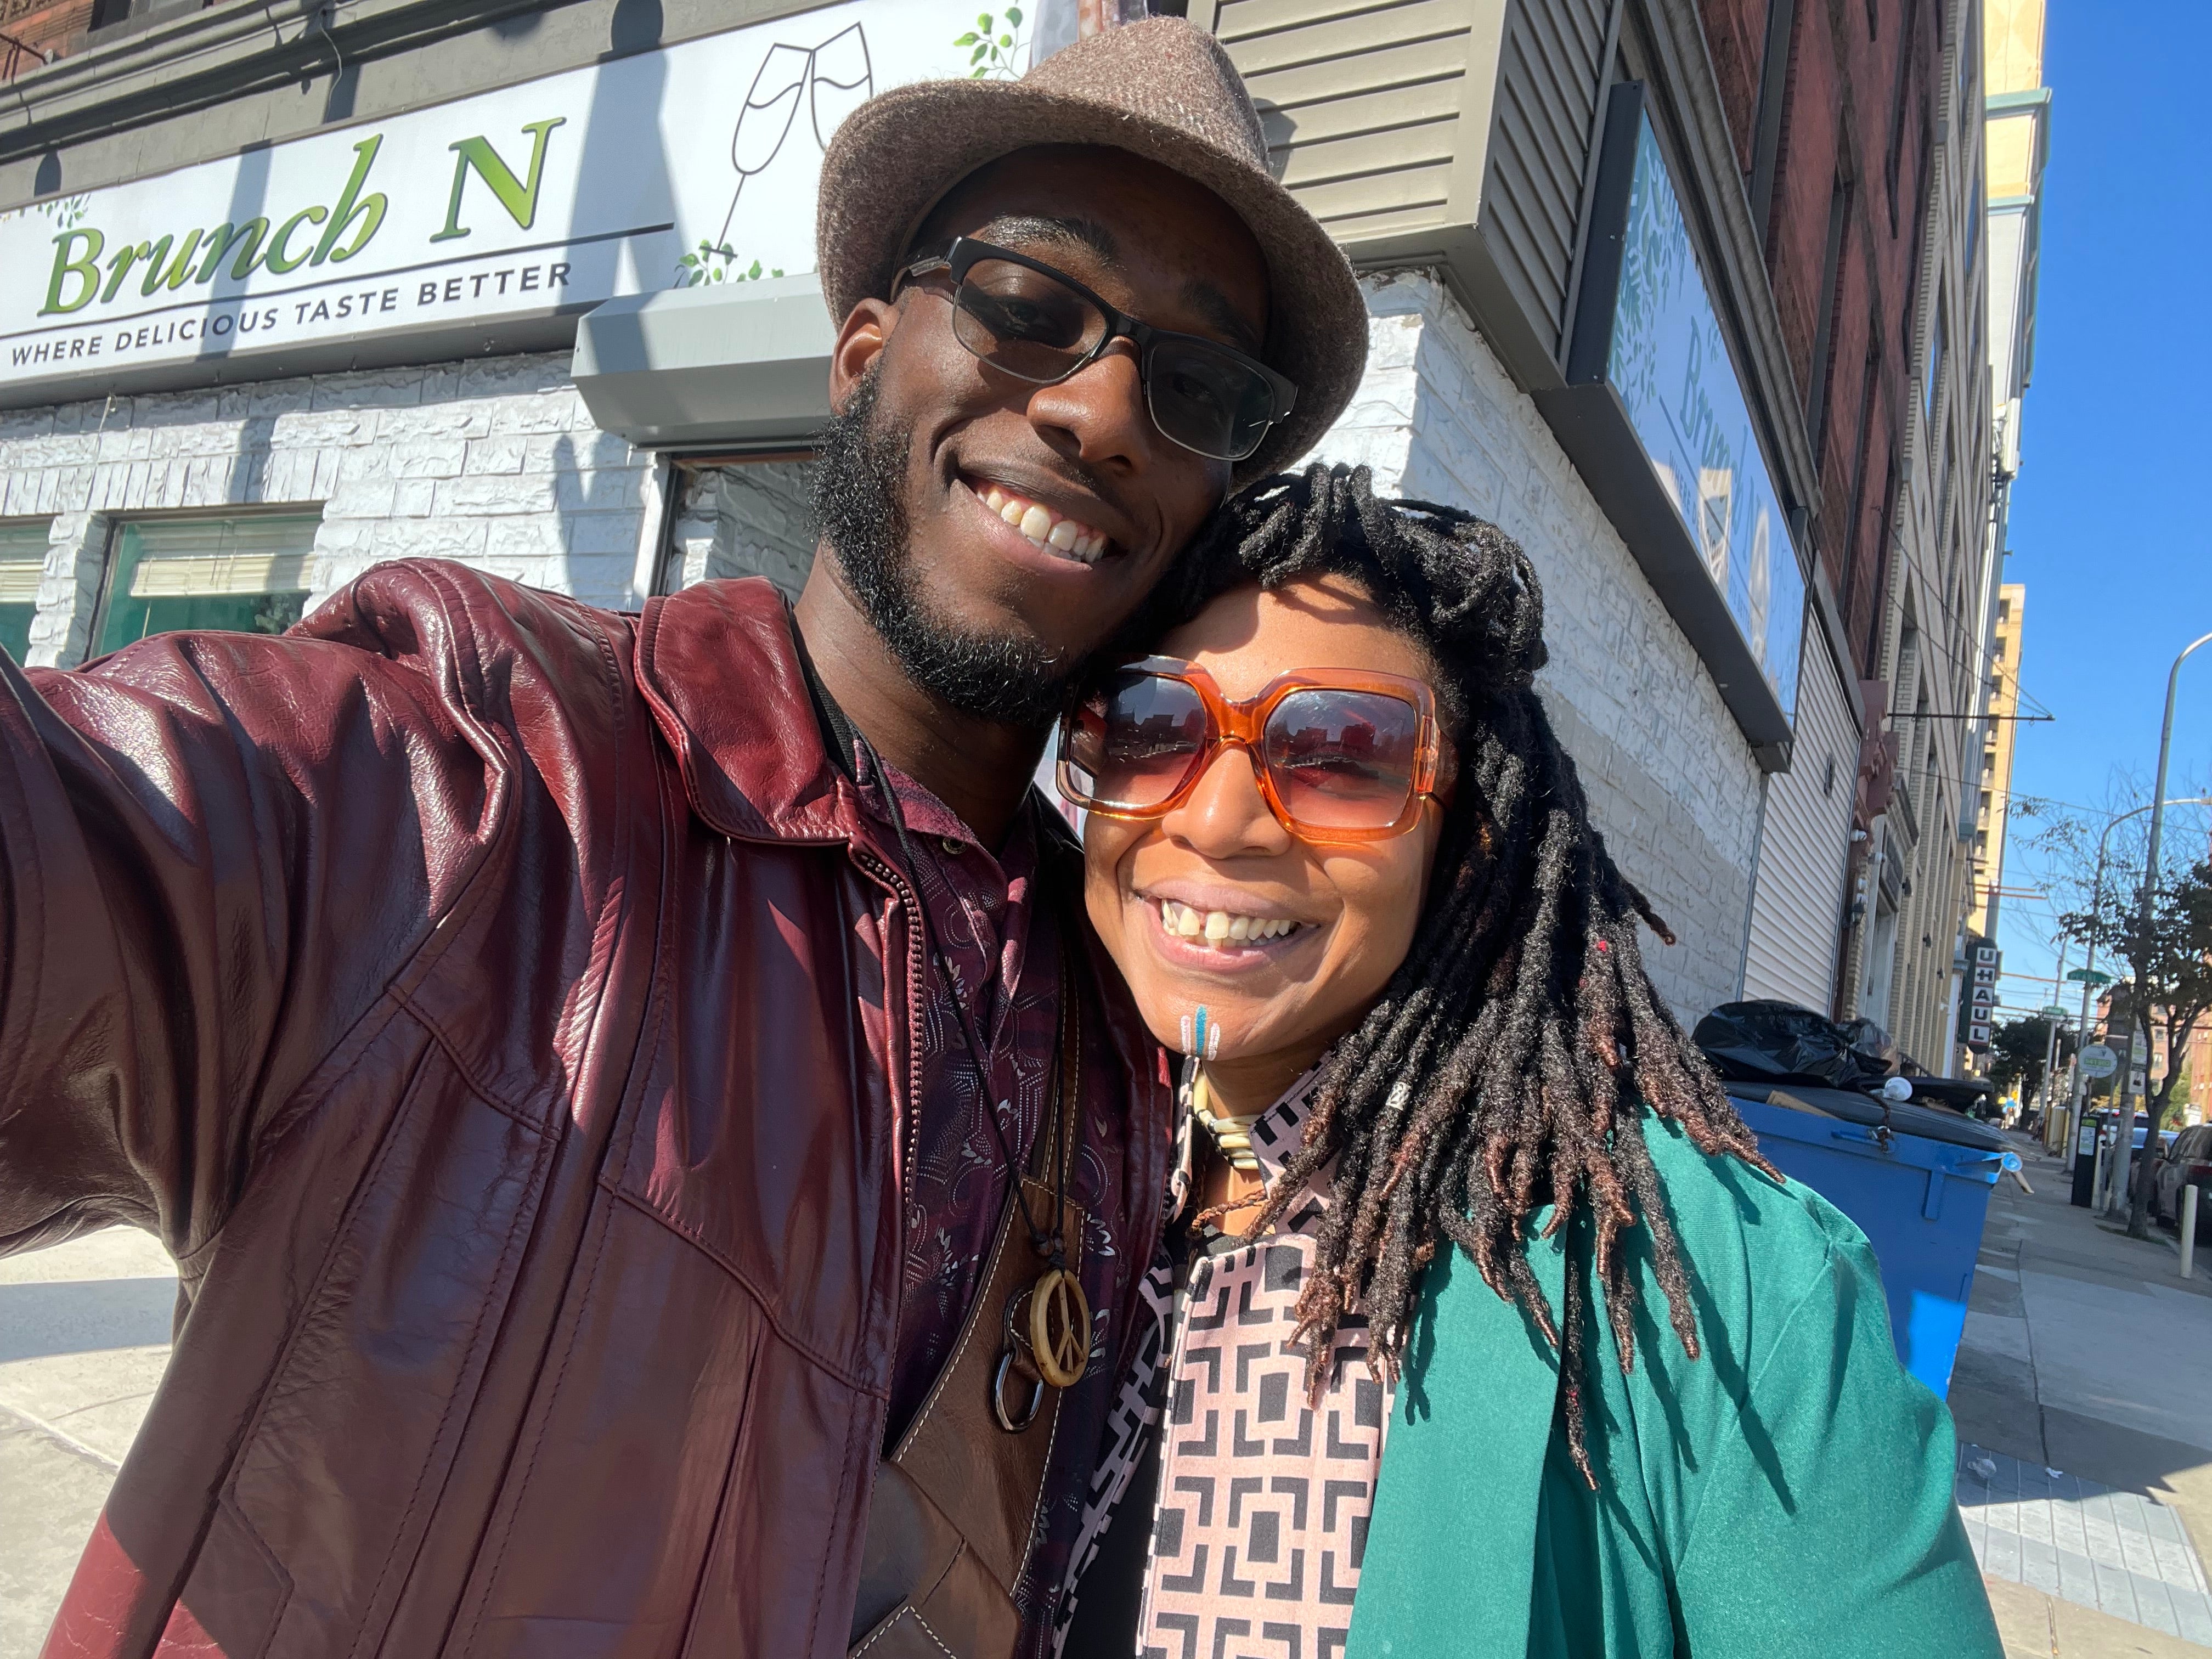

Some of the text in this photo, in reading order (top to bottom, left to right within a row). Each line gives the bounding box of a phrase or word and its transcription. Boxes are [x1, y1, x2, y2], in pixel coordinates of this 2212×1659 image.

[38, 116, 566, 317] Brunch N
[12, 262, 571, 366] WHERE DELICIOUS TASTE BETTER
